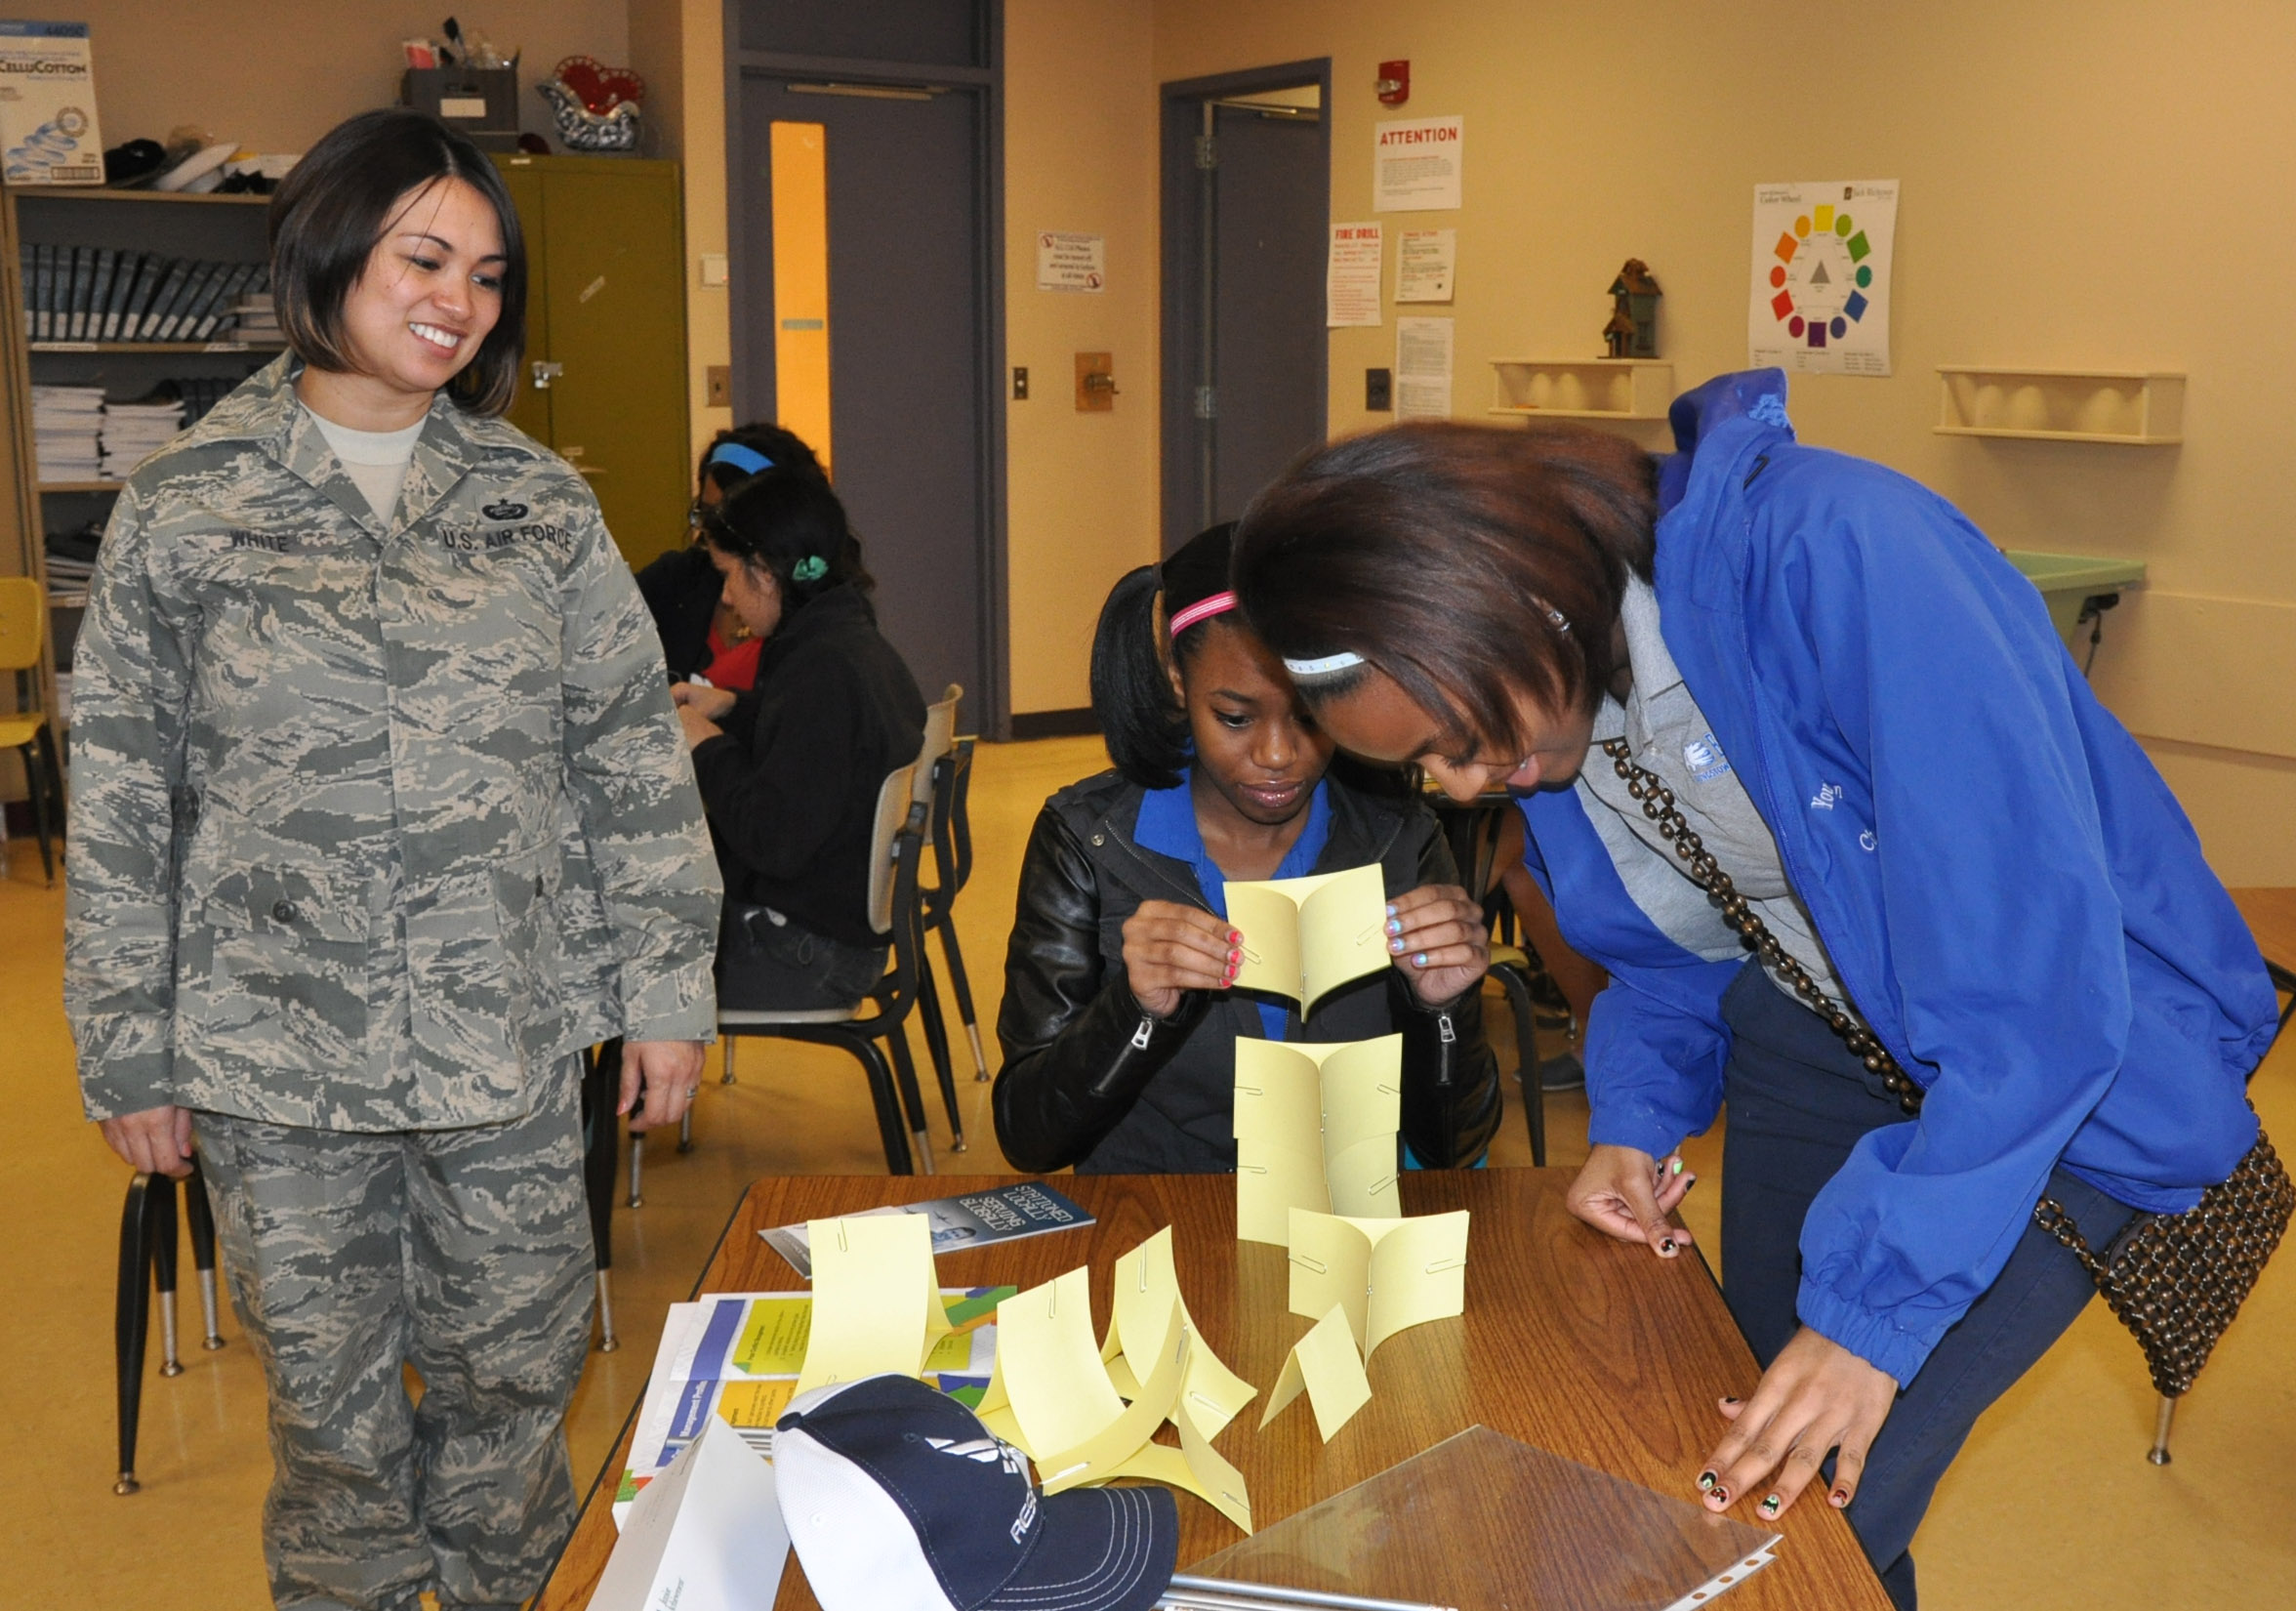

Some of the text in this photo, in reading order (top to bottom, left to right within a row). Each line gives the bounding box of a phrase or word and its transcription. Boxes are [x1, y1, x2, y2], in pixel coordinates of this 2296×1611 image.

[1379, 127, 1457, 145] ATTENTION
[1334, 227, 1379, 240] FIRE DRILL
[230, 530, 289, 553] WHITE
[442, 524, 572, 554] U.S. AIR FORCE
[959, 1197, 1013, 1231] GLOBALLY
[978, 1196, 1027, 1227] SERVING
[1003, 1191, 1052, 1220] LOCALLY
[1015, 1185, 1074, 1222] STATIONED
